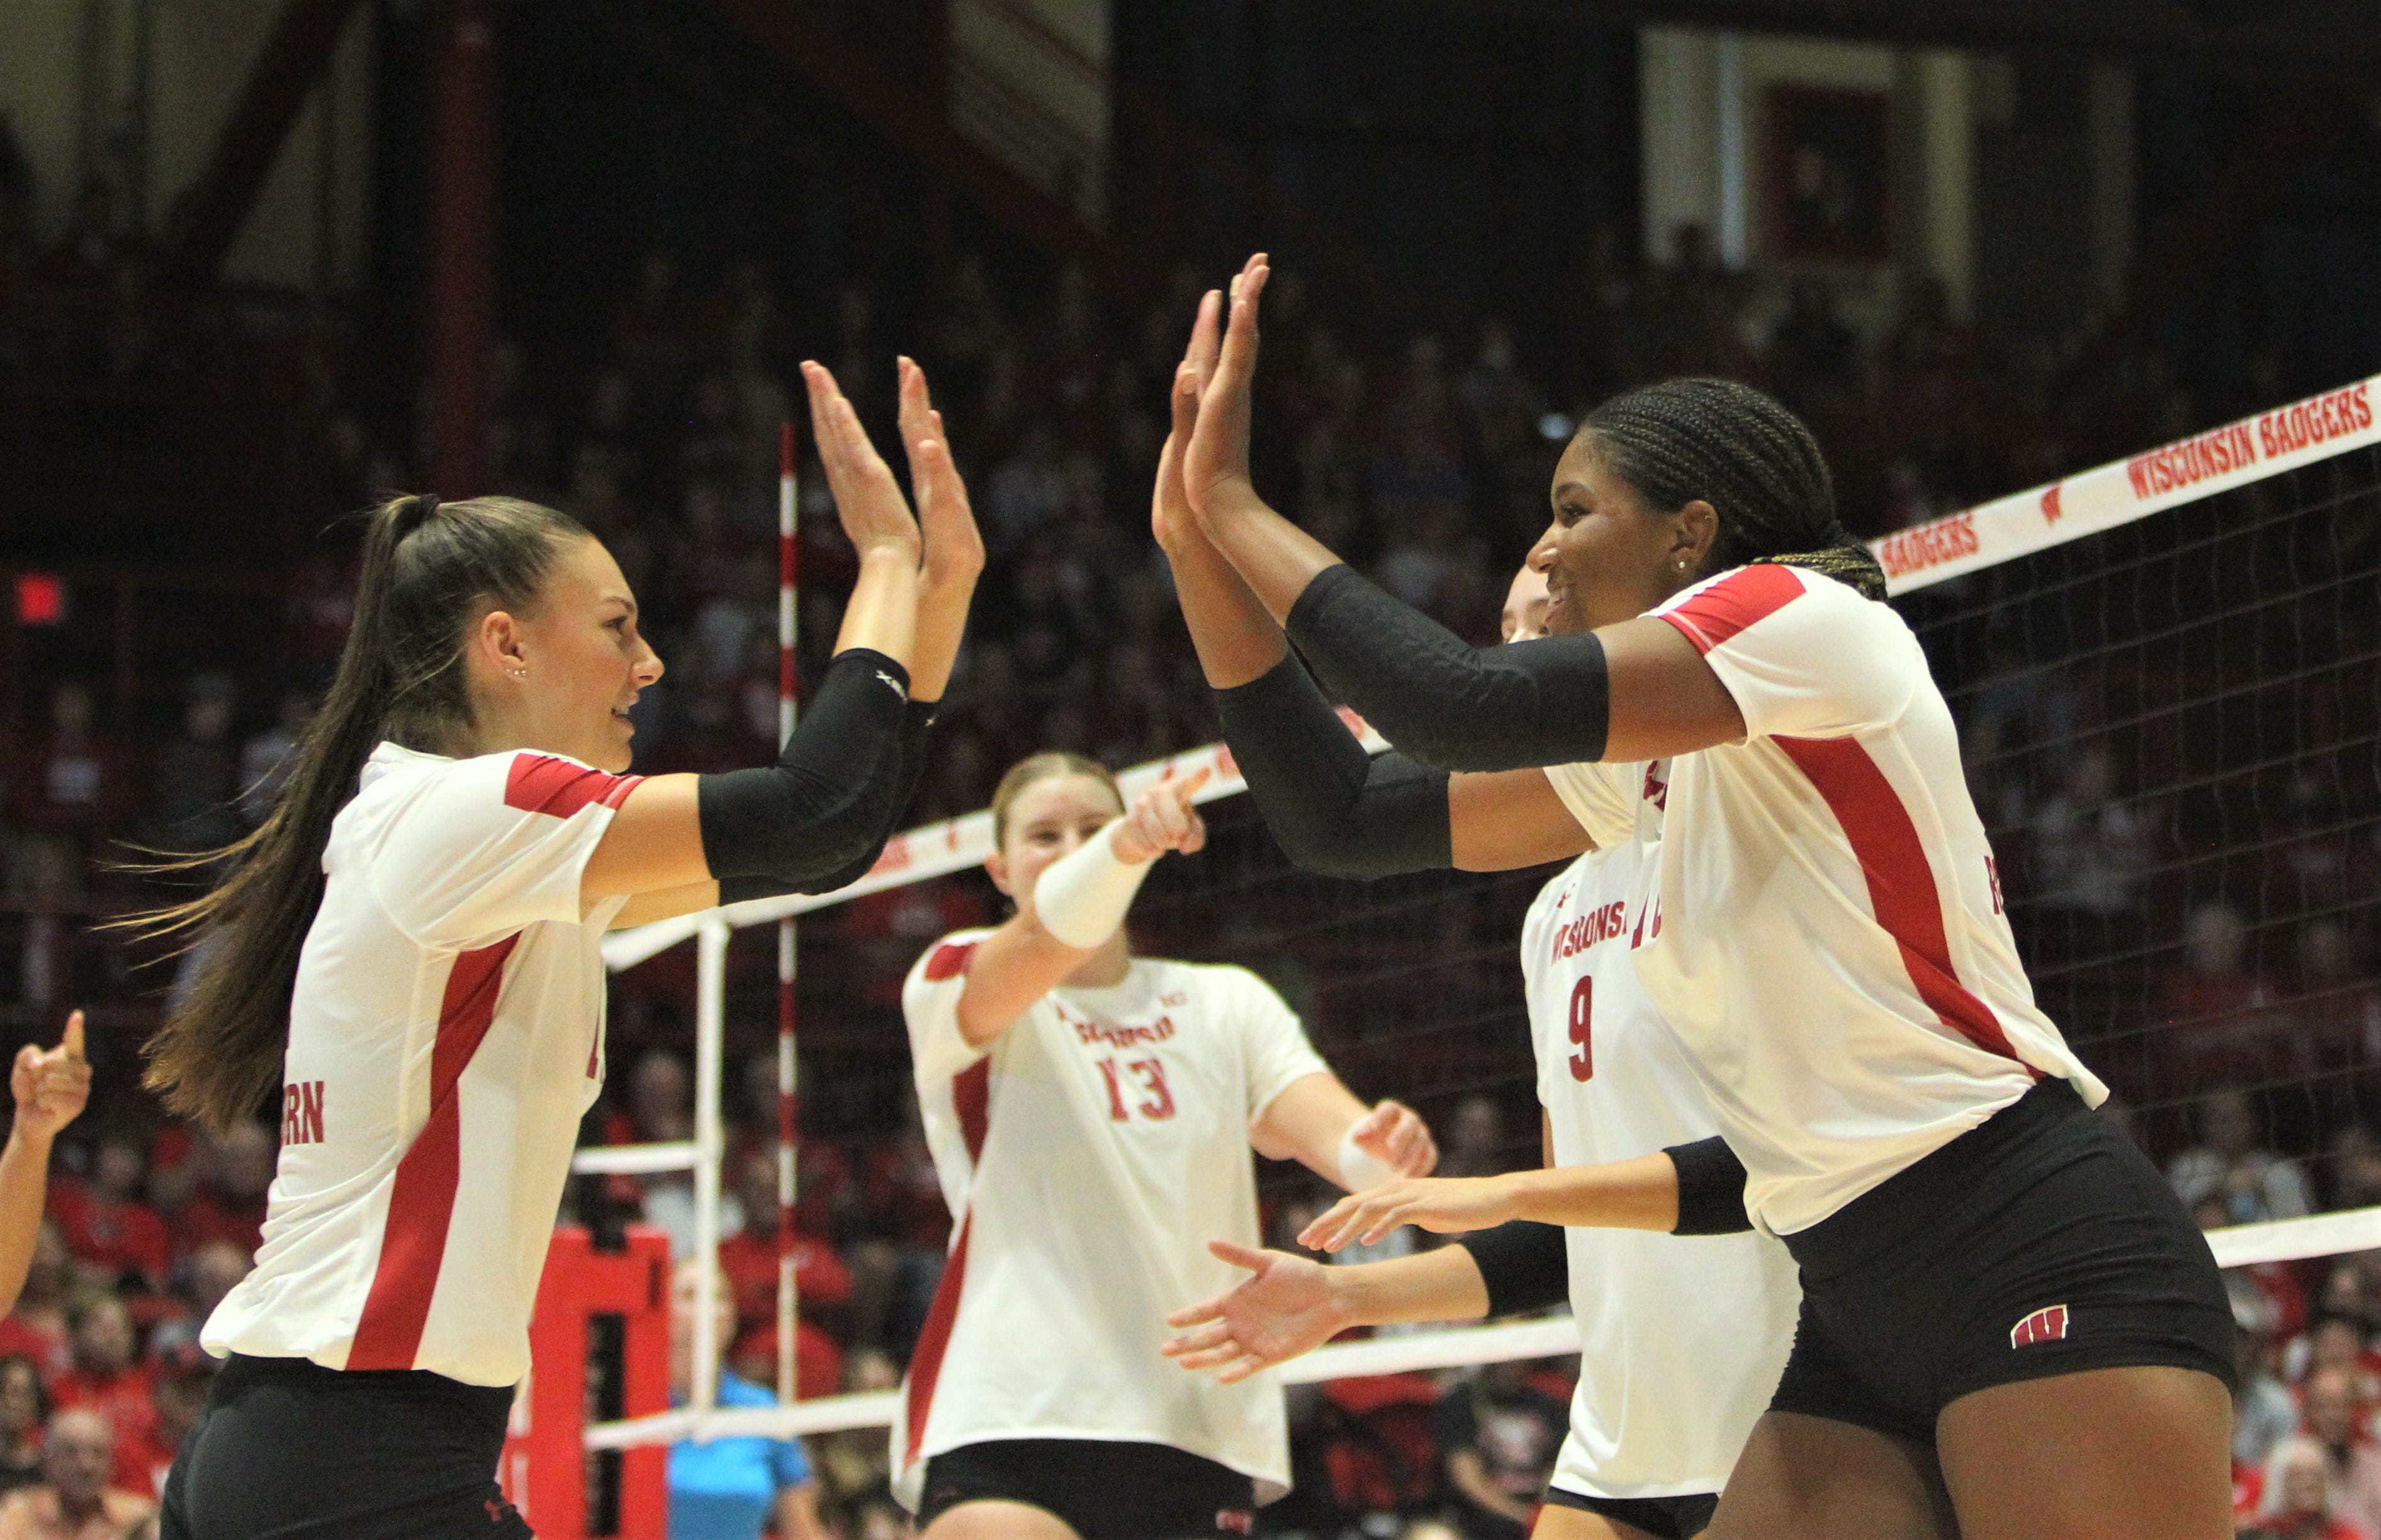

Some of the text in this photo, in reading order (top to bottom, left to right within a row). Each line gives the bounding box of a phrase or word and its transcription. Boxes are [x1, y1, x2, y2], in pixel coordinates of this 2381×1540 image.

[2127, 381, 2372, 500] WISCONSIN BADGERS
[1882, 511, 1979, 579] BADGERS
[1568, 975, 1593, 1082] 9
[1096, 1056, 1177, 1121] 13
